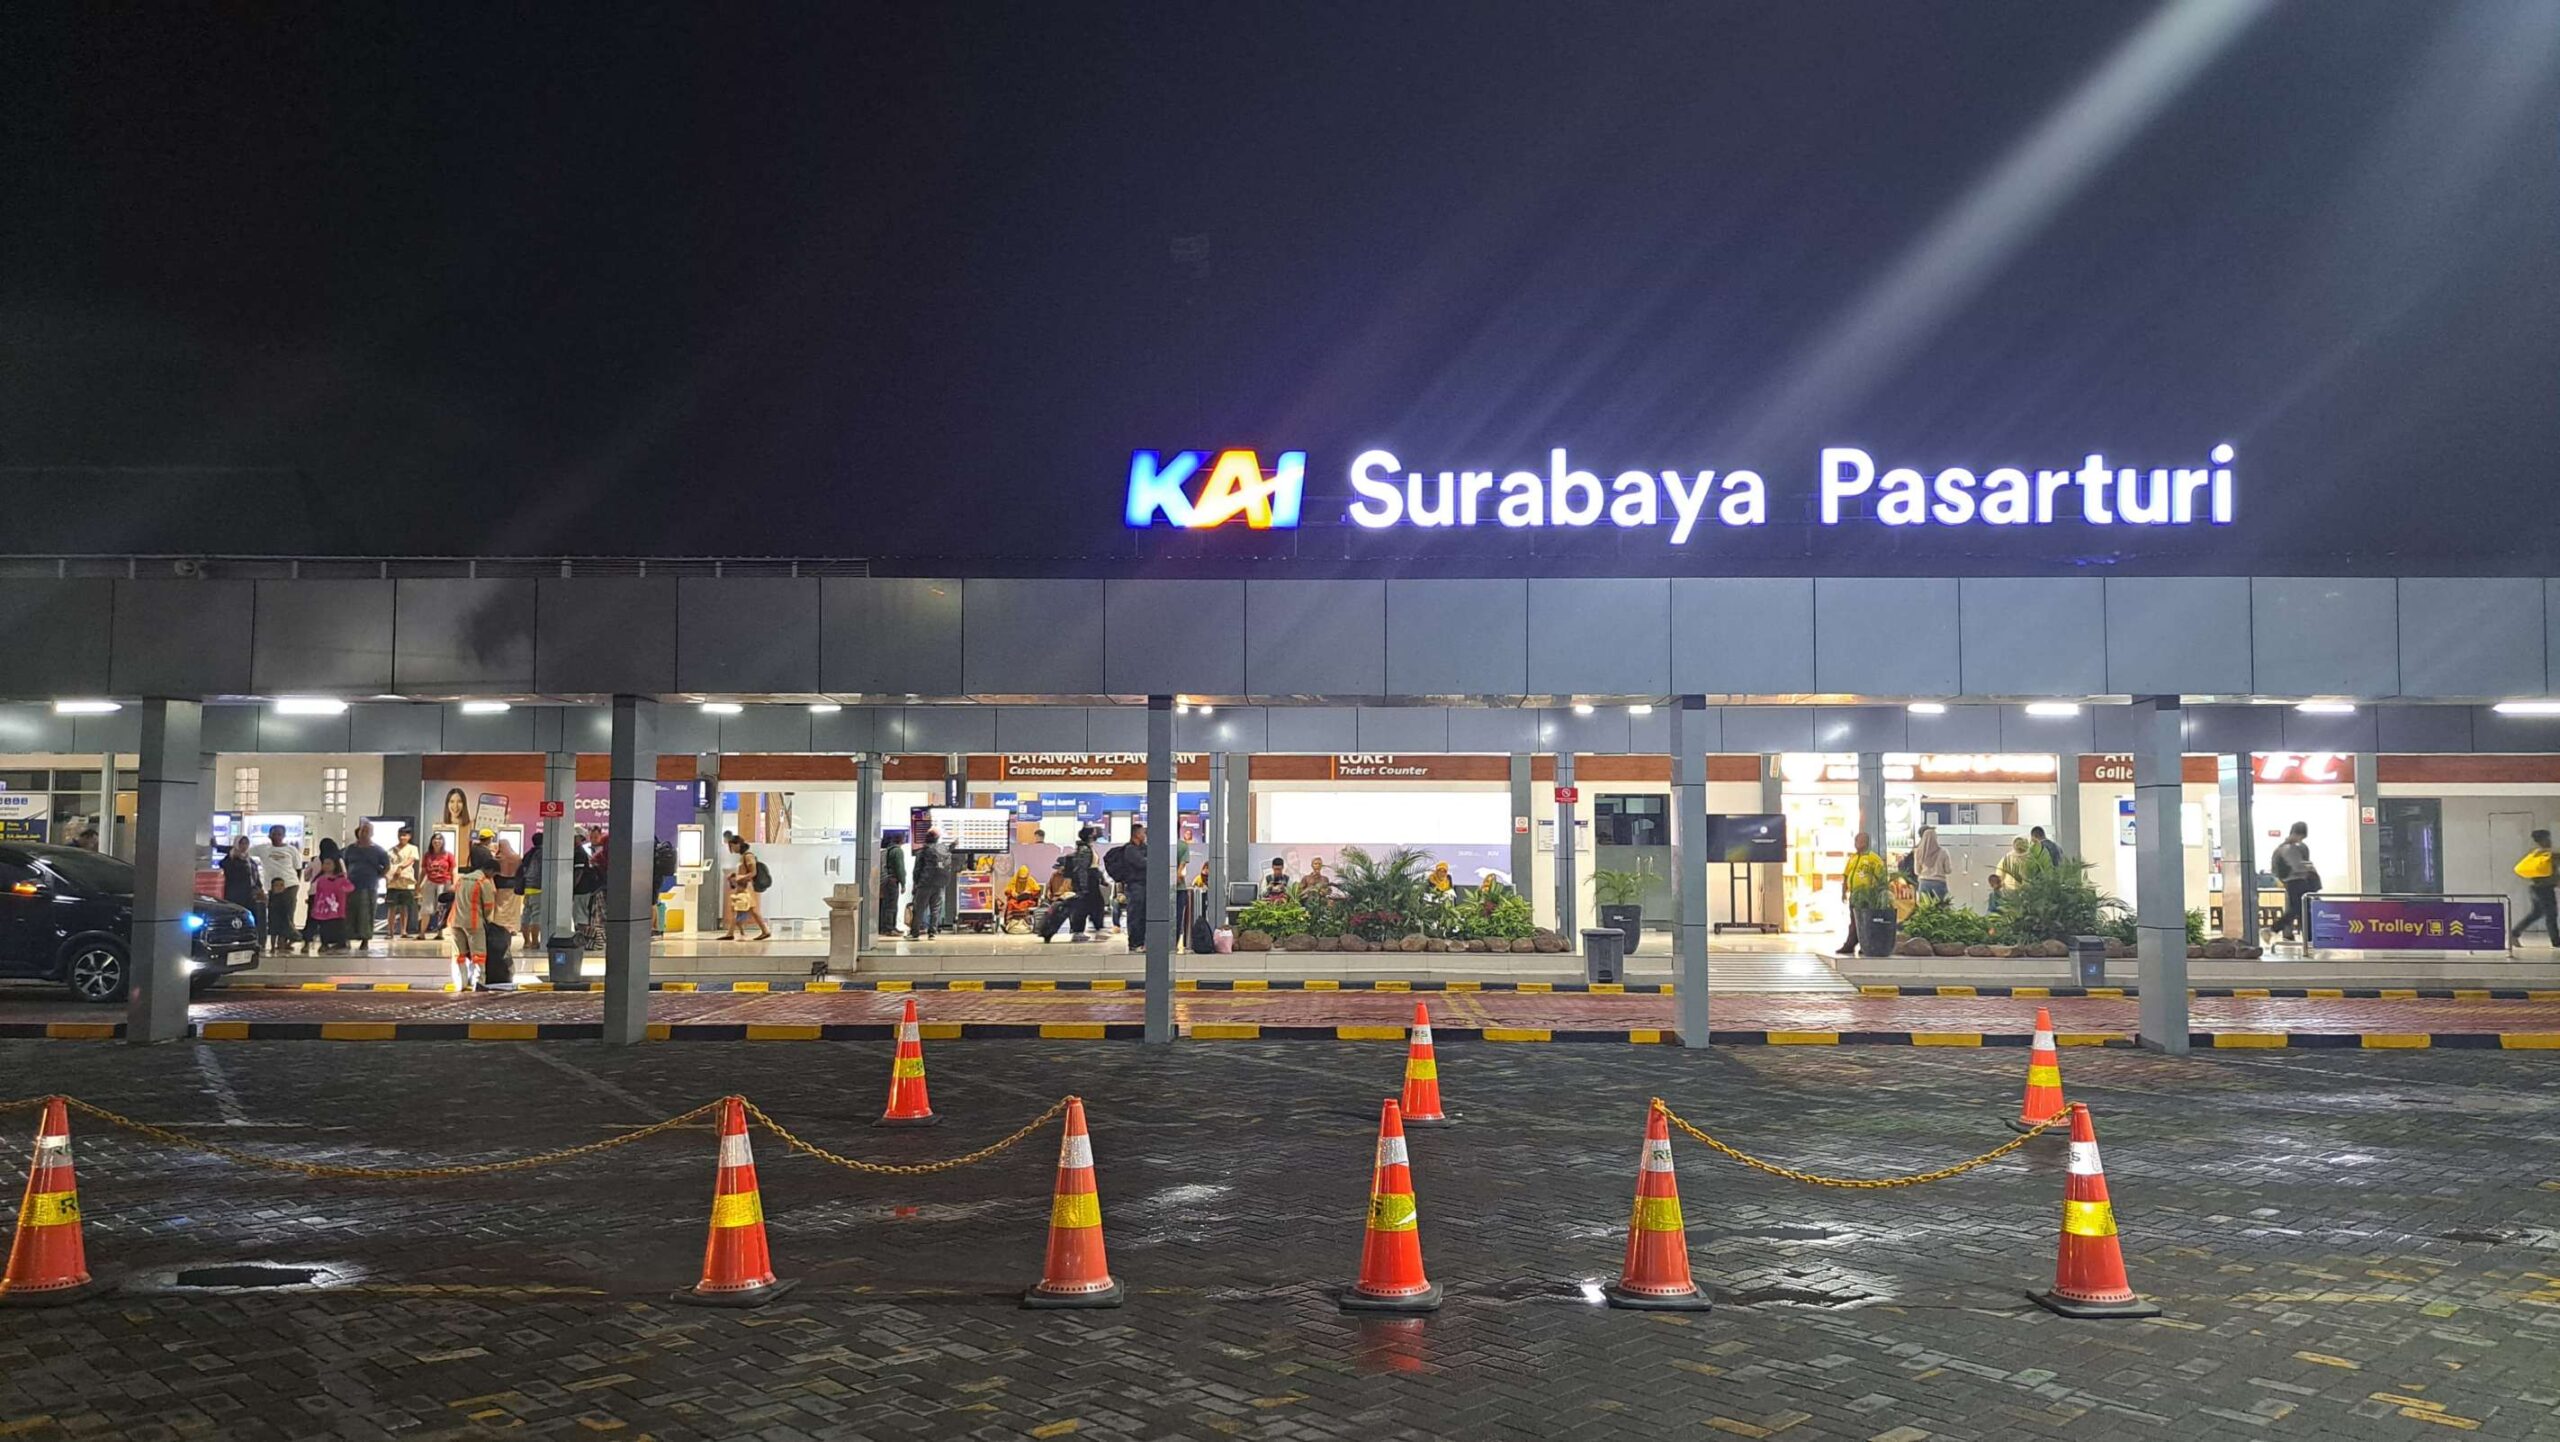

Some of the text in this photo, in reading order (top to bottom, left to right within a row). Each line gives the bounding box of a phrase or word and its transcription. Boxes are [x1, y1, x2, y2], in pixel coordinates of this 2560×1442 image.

[1126, 449, 1306, 529] KAI
[1349, 443, 2236, 545] Surabaya Pasarturi
[1095, 753, 1196, 764] PELANAN
[1009, 766, 1114, 776] Customer Service
[1340, 766, 1428, 775] Ticket Counter
[2095, 766, 2134, 780] Galle
[2367, 918, 2424, 936] Trolley
